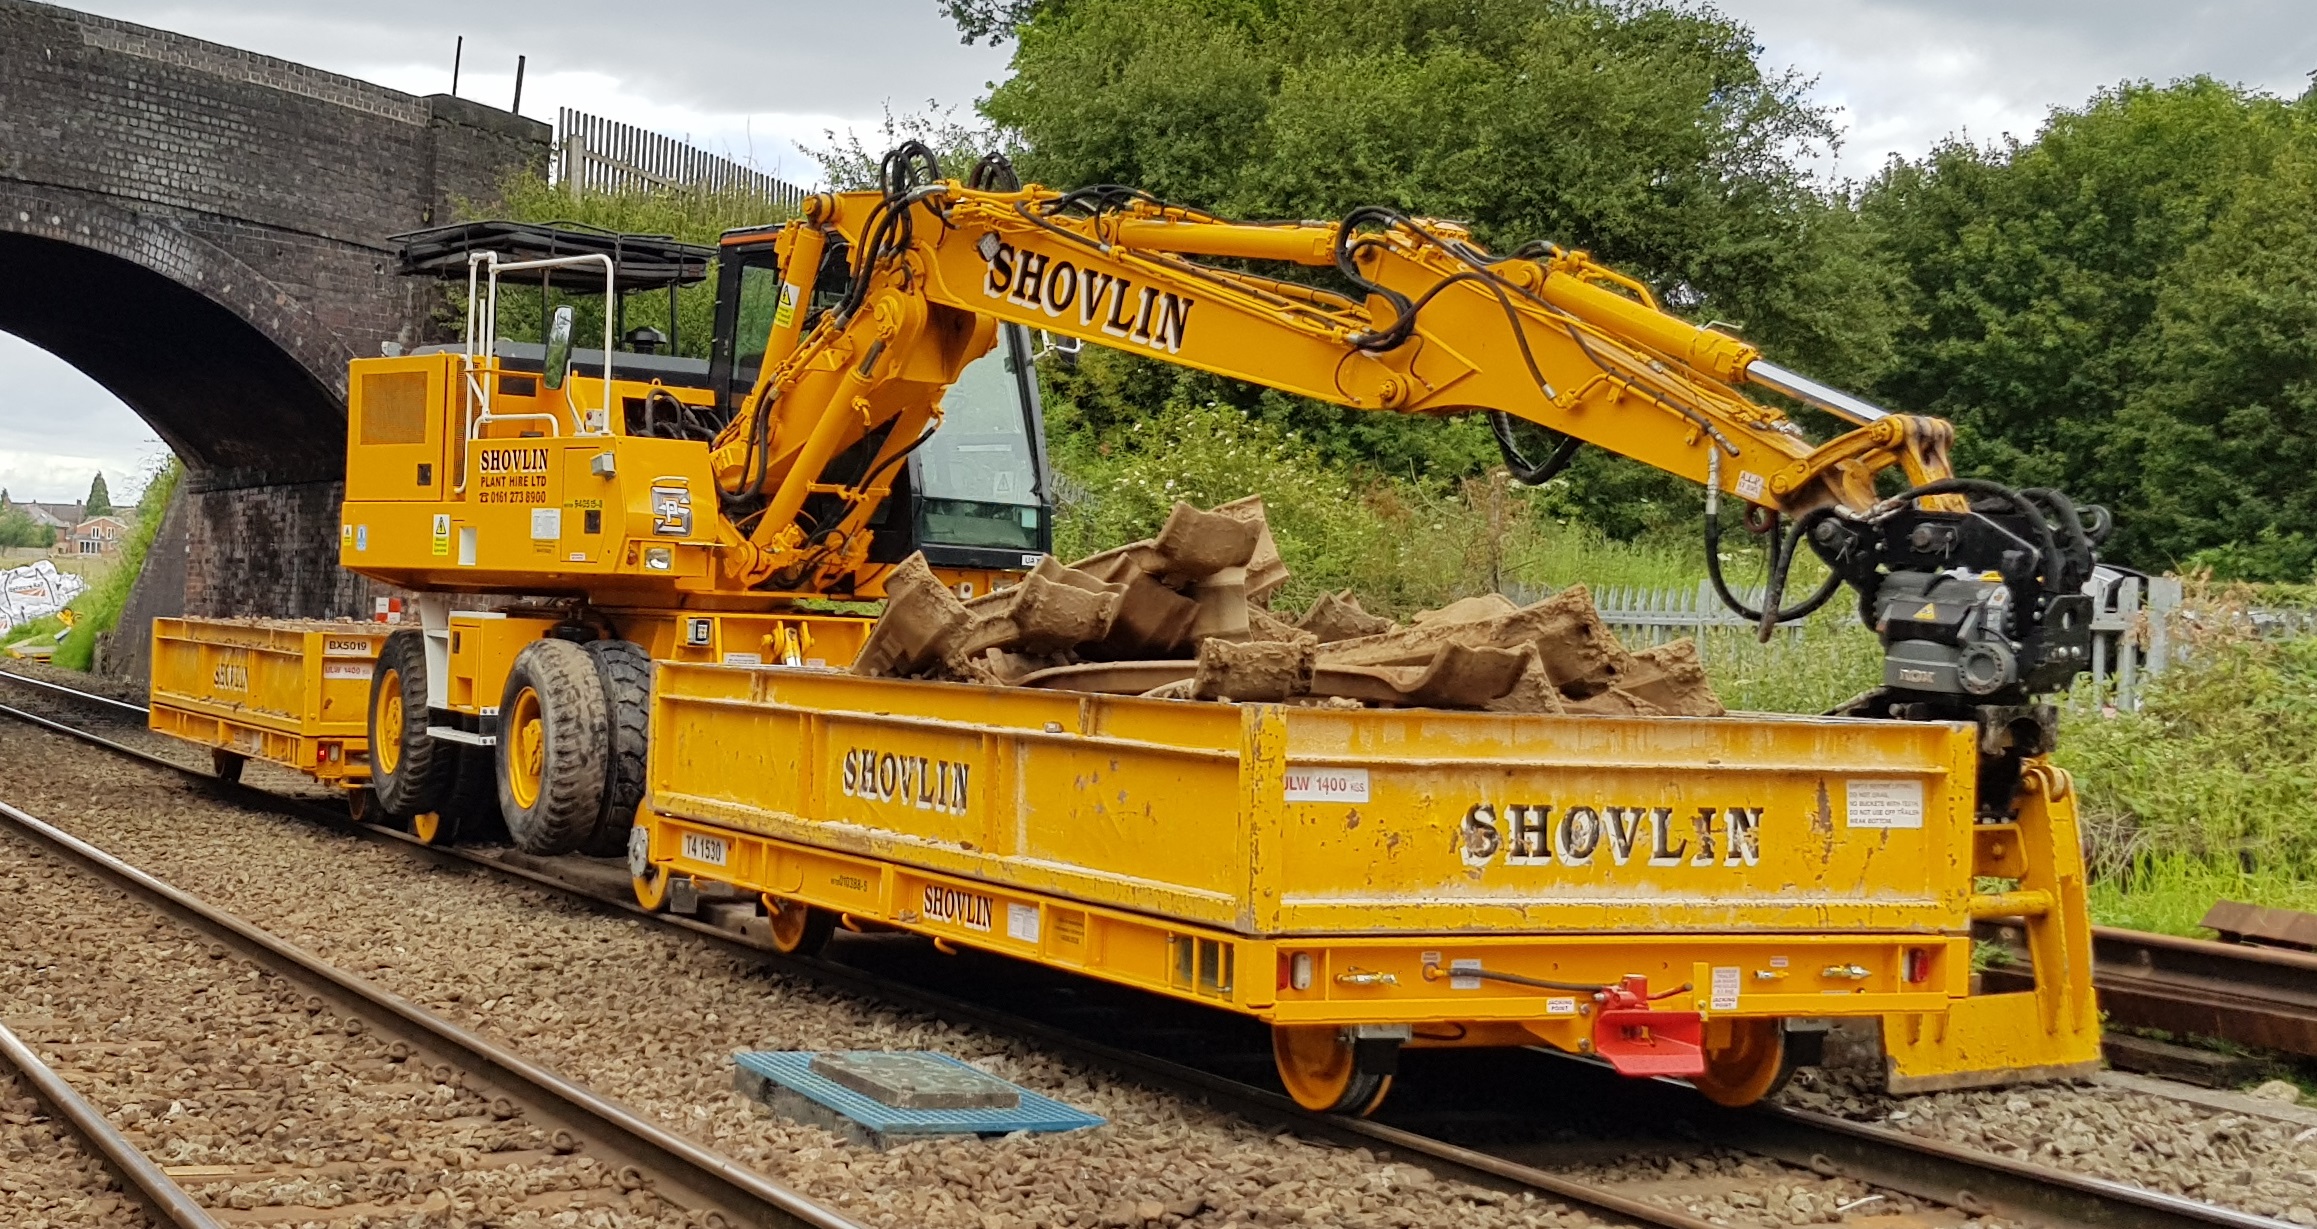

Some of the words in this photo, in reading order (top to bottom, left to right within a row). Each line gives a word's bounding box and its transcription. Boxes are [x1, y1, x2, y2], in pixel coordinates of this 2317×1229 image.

[984, 243, 1194, 354] SHOVLIN
[479, 448, 549, 473] SHOVLIN
[480, 475, 507, 488] PLANT
[509, 475, 529, 488] HIRE
[531, 475, 547, 487] LTD
[490, 491, 508, 504] 0161
[509, 491, 525, 504] 273
[525, 491, 546, 504] 8900
[329, 640, 368, 651] BX5019
[843, 746, 970, 817] SHOVLIN
[1317, 776, 1347, 796] 1400
[686, 834, 698, 857] T4
[700, 836, 722, 863] 1530
[1458, 802, 1764, 868] SHOVLIN
[923, 883, 994, 933] SHOVLIN
